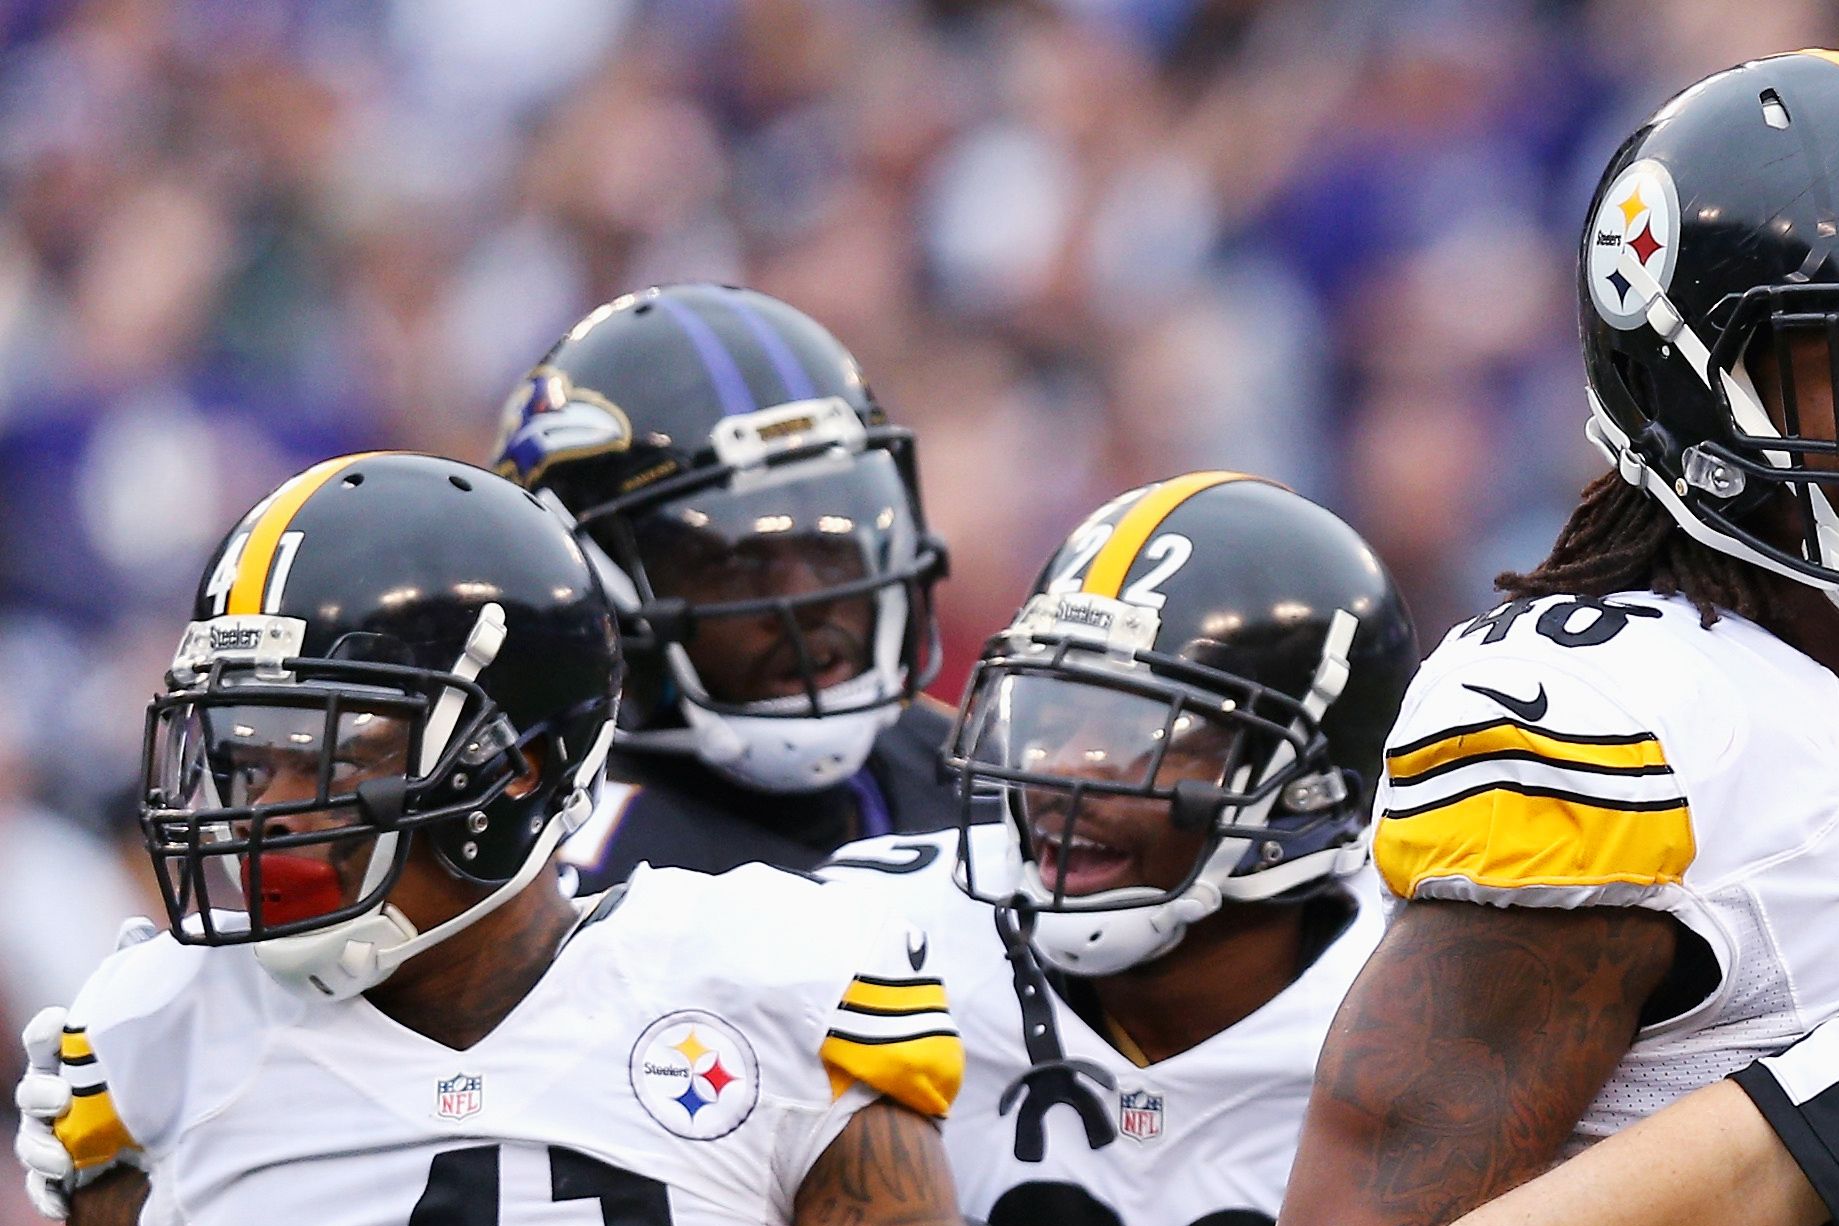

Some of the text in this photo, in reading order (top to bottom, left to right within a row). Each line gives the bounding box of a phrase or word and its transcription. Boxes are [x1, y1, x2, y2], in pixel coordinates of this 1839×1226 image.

[206, 531, 305, 615] 41
[1048, 523, 1193, 608] 22
[210, 621, 262, 650] Steelers
[644, 1061, 691, 1079] Steelers
[441, 1091, 479, 1114] NFL
[1124, 1109, 1160, 1136] NFL
